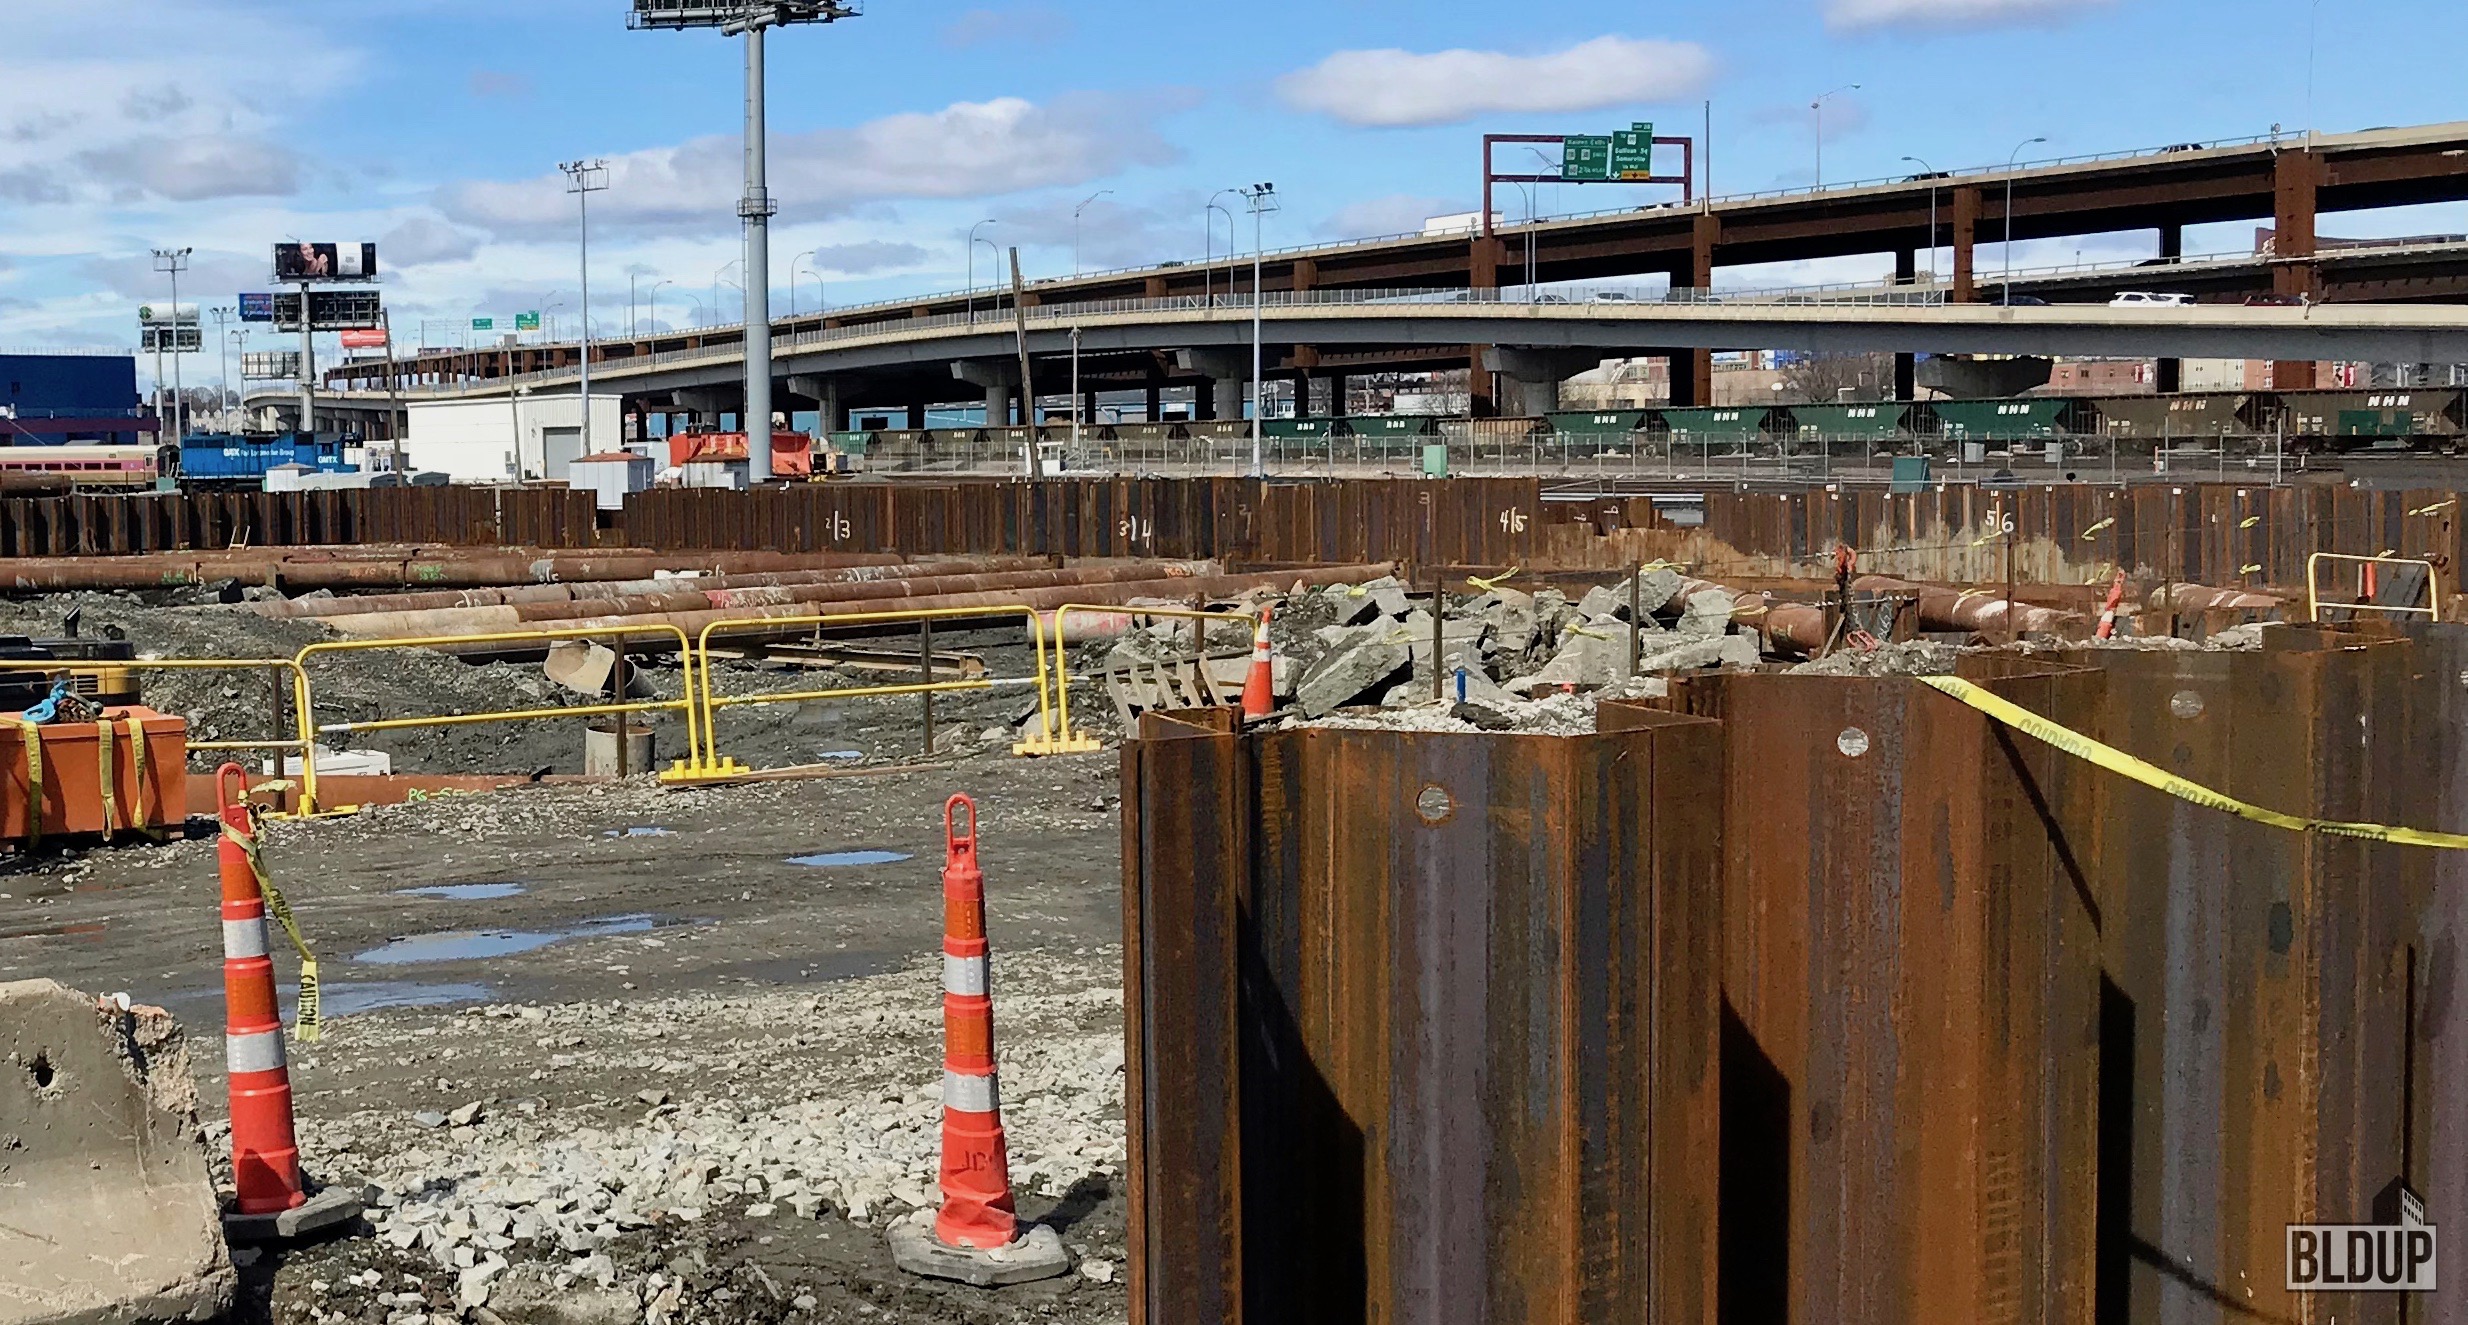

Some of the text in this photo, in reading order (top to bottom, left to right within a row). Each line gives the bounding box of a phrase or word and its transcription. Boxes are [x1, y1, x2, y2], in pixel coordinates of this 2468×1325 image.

[2367, 395, 2411, 407] NHN
[1847, 408, 1876, 418] NHN
[1997, 404, 2030, 415] NHN
[299, 973, 317, 1027] CAUTION
